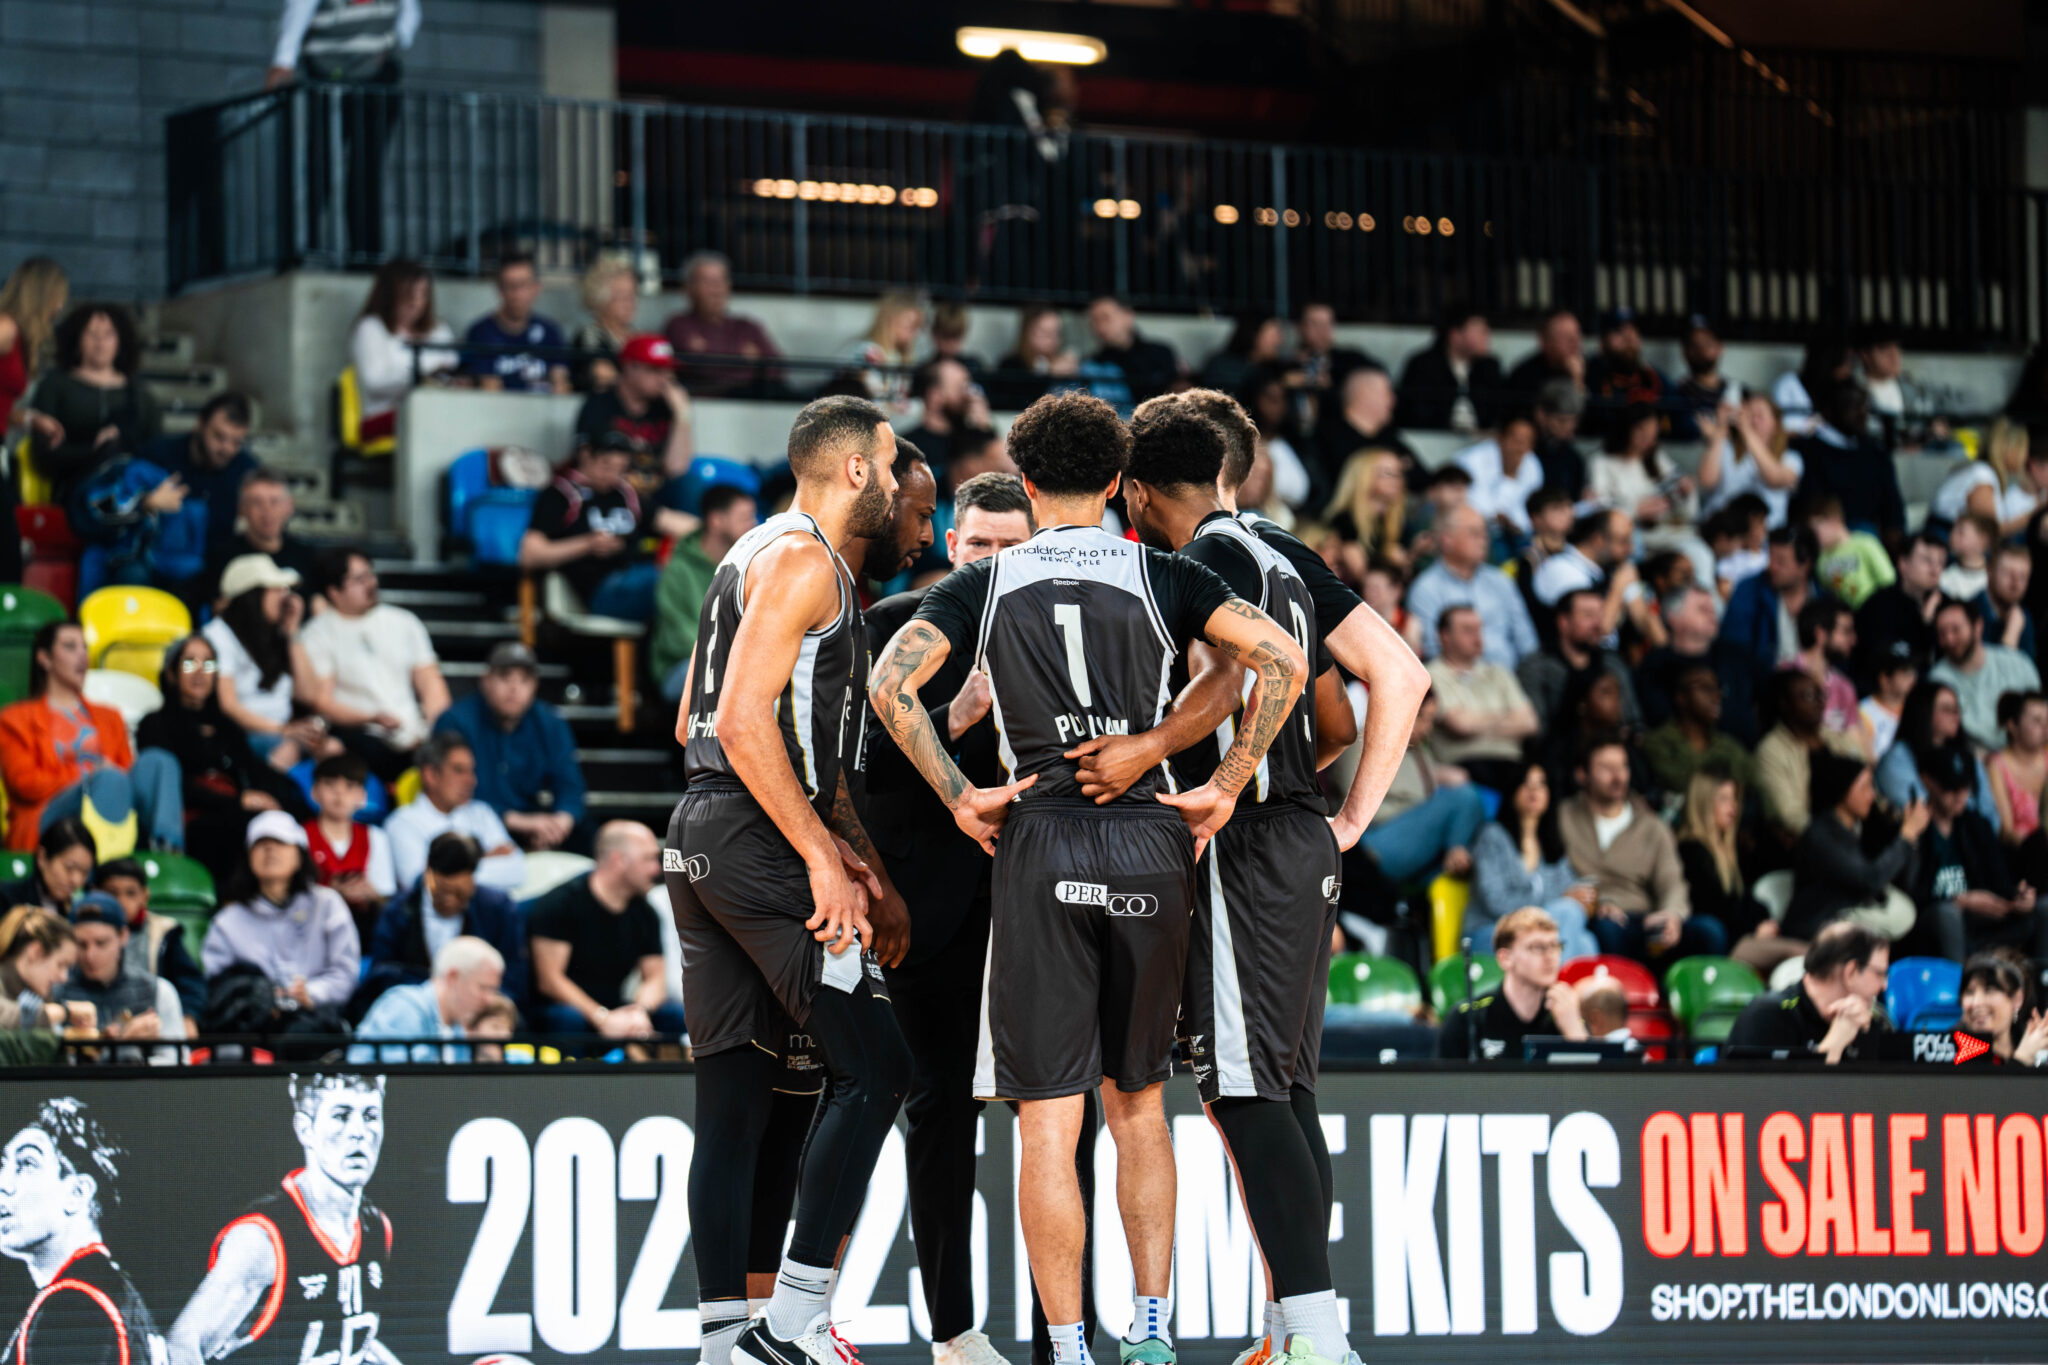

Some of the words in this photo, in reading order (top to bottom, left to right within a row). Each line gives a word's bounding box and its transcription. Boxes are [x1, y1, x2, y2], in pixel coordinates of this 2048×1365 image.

[1040, 556, 1101, 568] NEWCSTLE
[1078, 548, 1127, 558] HOTEL
[1053, 578, 1080, 587] Reebok
[1054, 603, 1092, 708] 1
[1640, 1110, 1748, 1259] ON
[1758, 1110, 1931, 1258] SALE
[1942, 1111, 2048, 1257] NO
[1370, 1110, 1623, 1336] KITS
